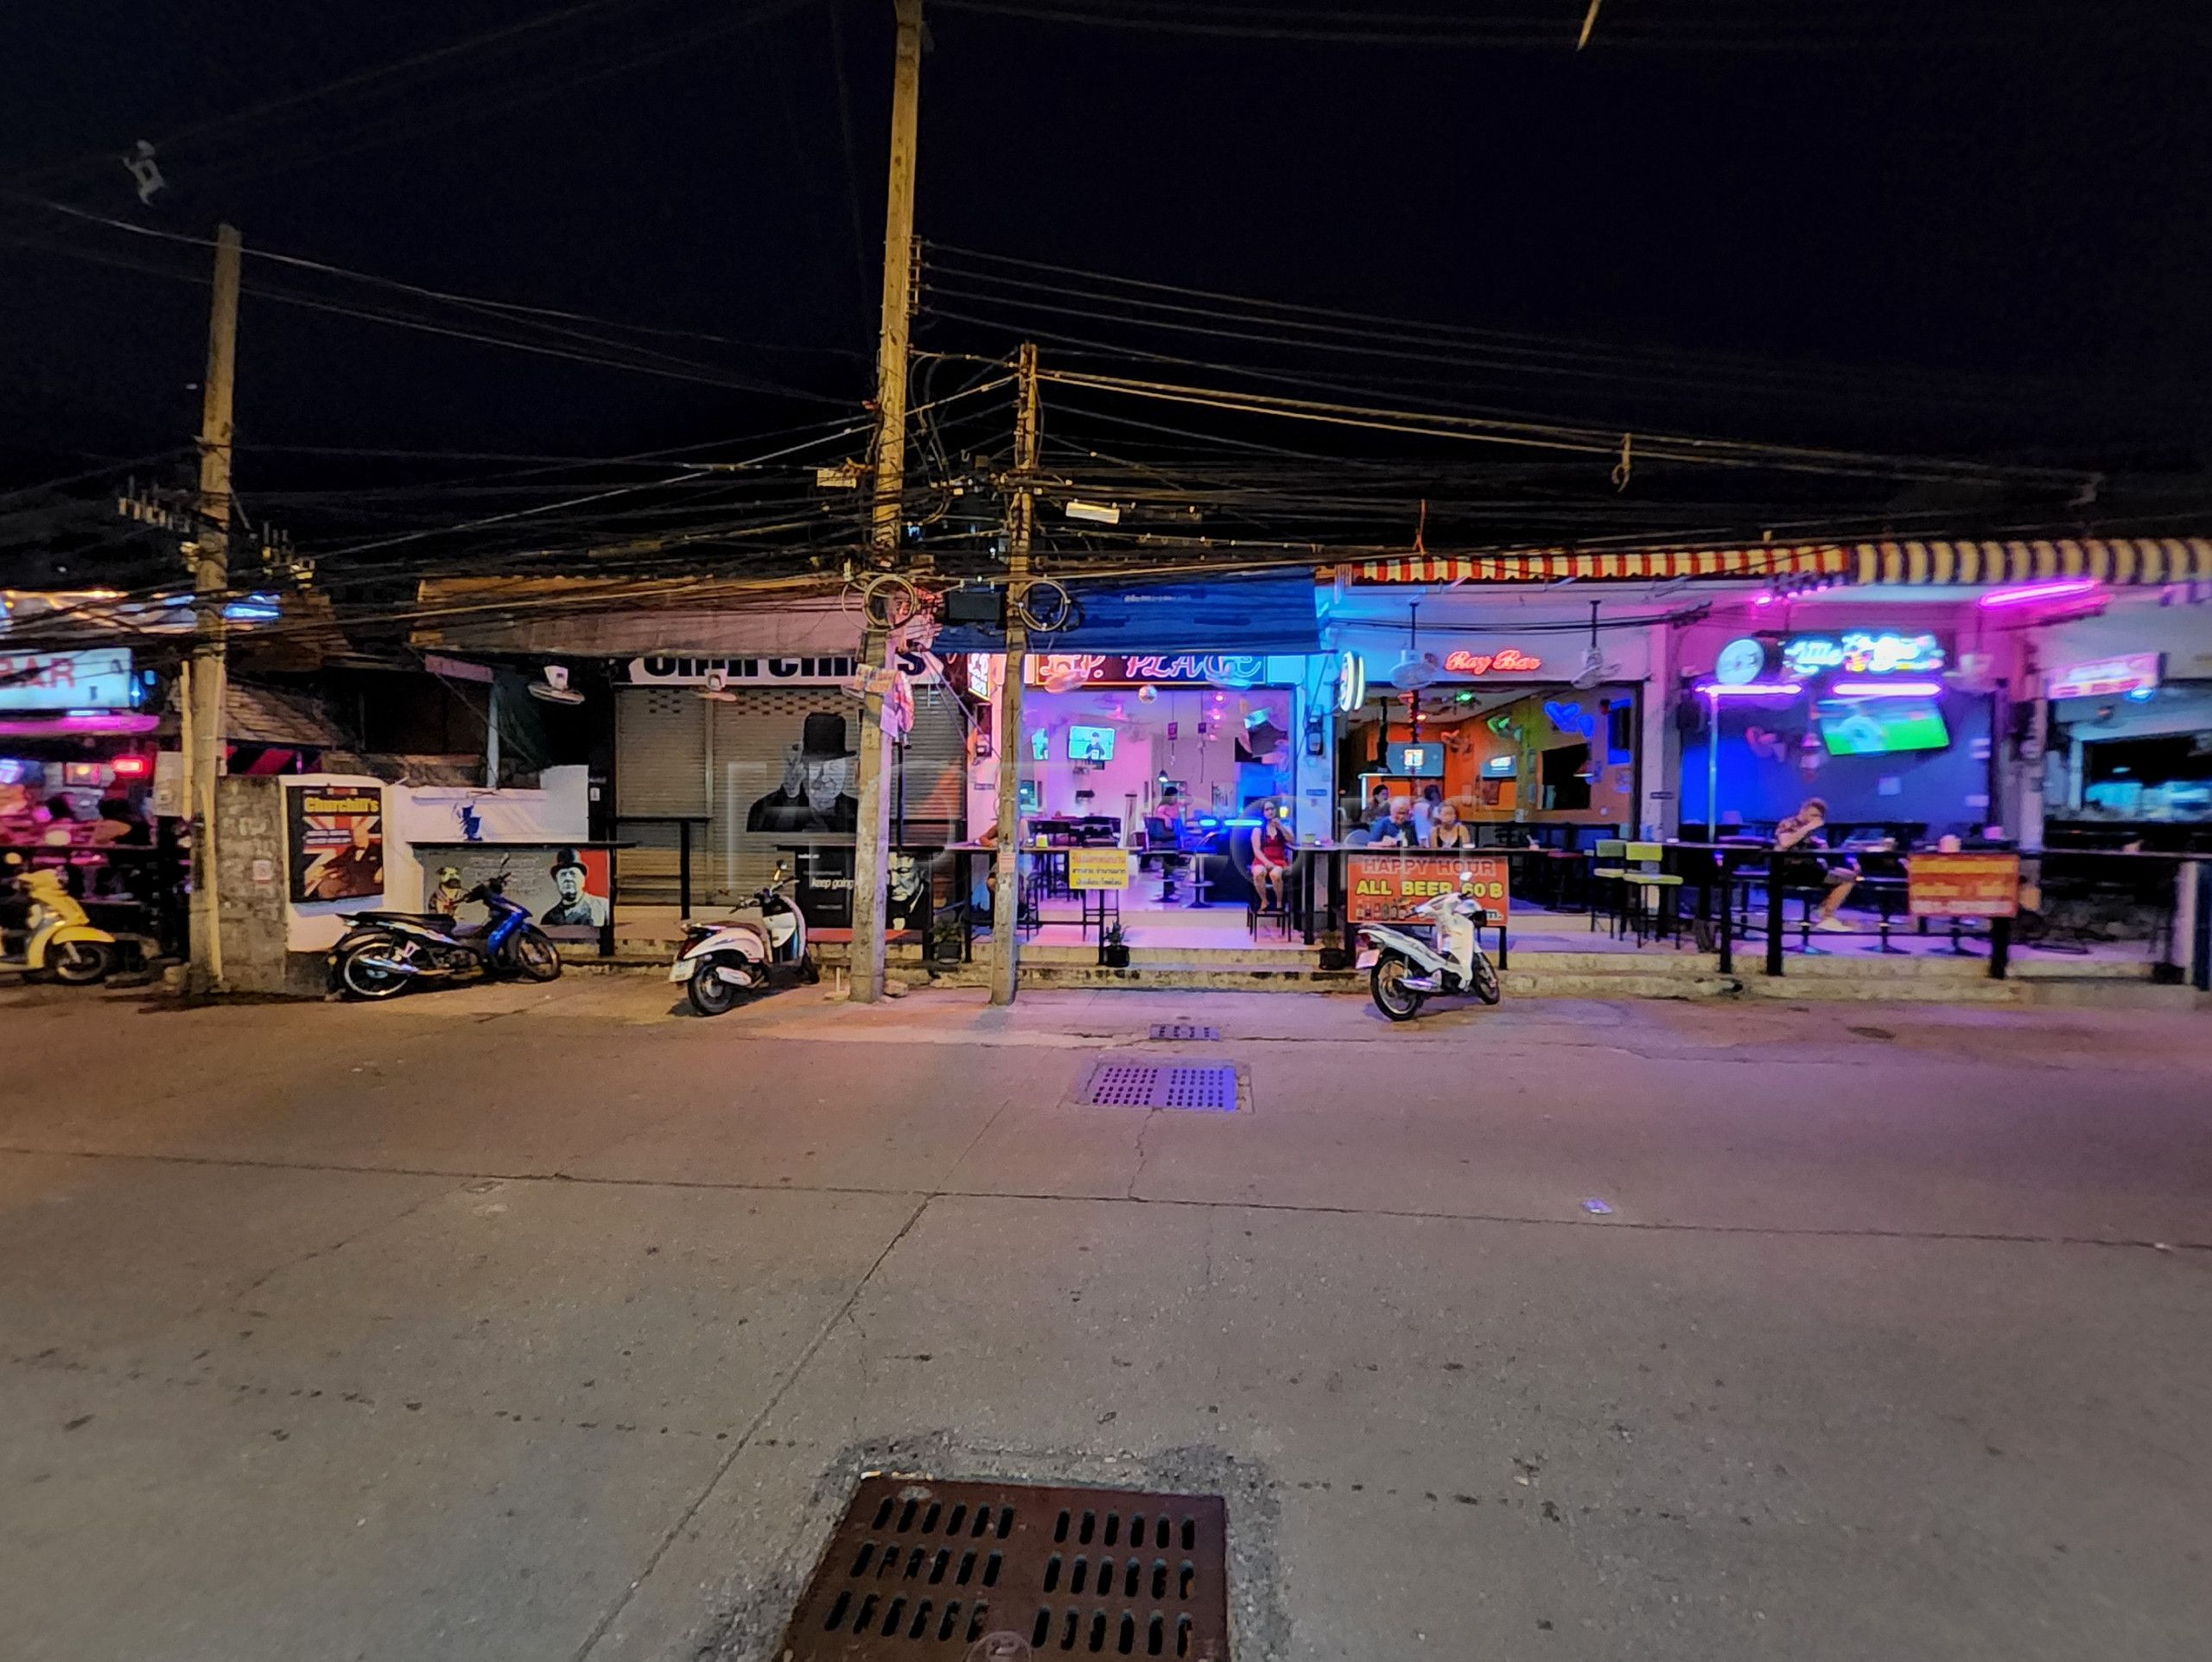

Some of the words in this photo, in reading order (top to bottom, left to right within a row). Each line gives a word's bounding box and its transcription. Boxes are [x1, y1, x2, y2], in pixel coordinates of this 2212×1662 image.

[1445, 650, 1492, 675] Ray
[1492, 649, 1541, 671] Bar
[1362, 856, 1427, 875] HAPPY
[1437, 858, 1497, 876] HOUR
[1356, 880, 1393, 896] ALL
[1402, 880, 1454, 897] BEER
